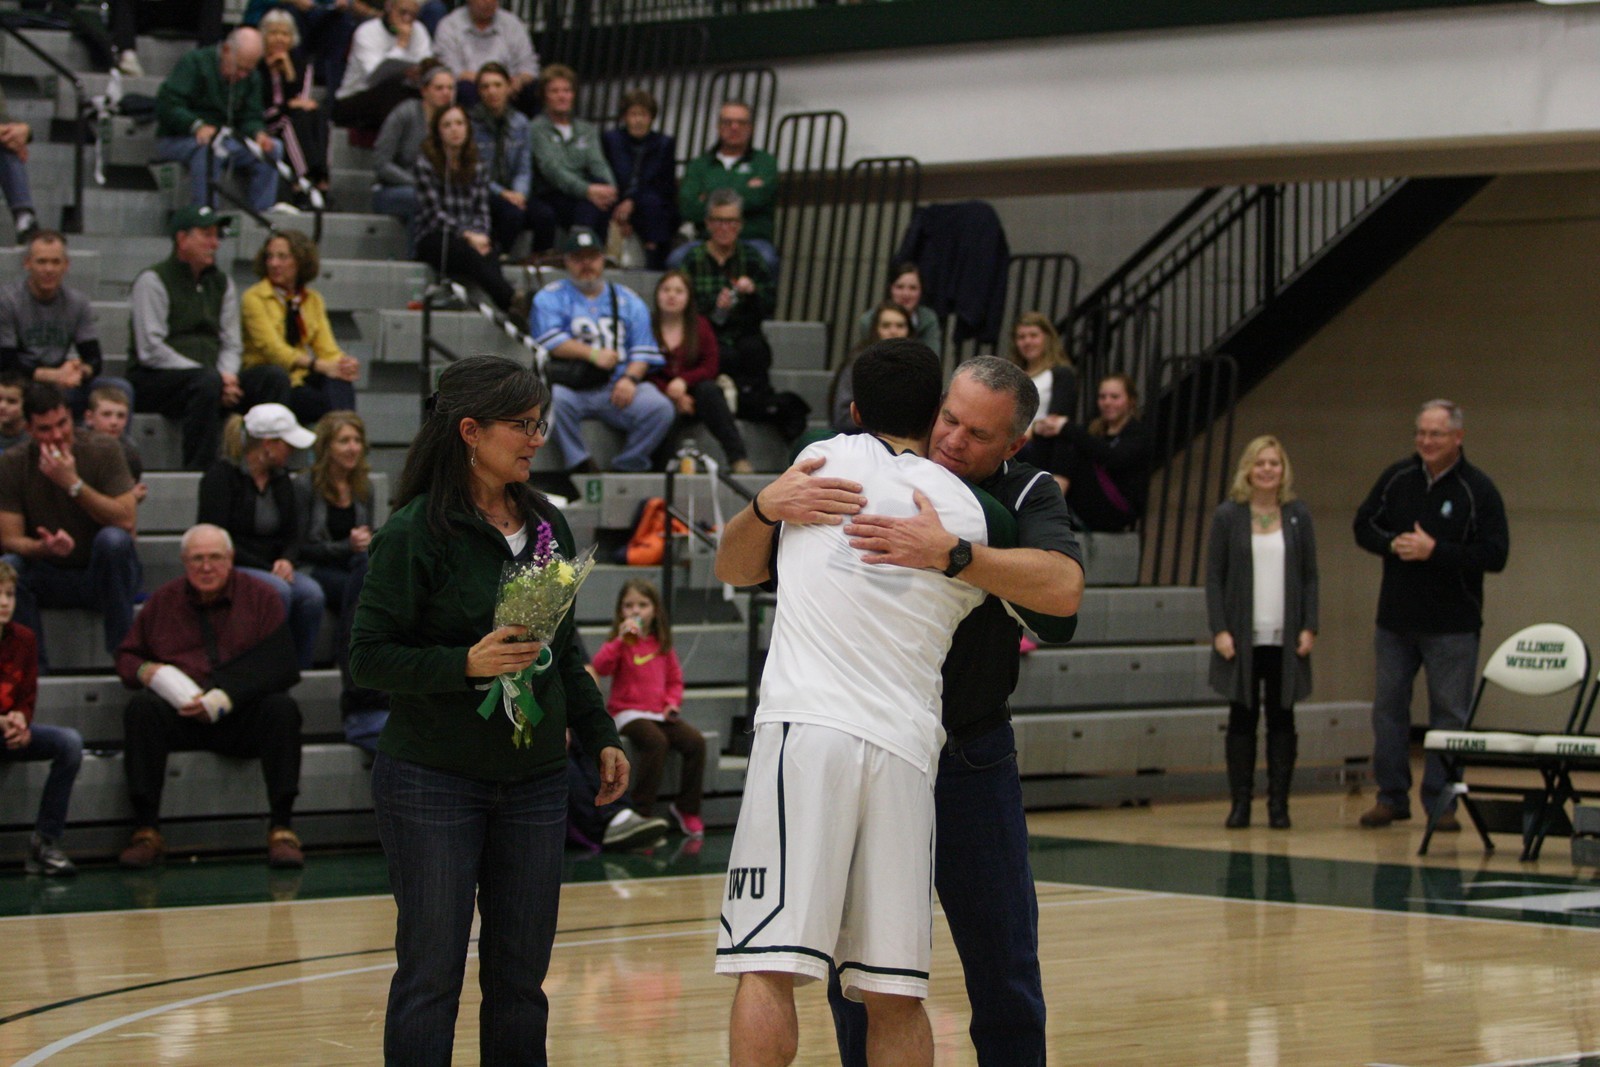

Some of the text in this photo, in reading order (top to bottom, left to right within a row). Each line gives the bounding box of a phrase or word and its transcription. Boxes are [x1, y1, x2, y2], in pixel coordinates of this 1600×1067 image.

[1516, 639, 1566, 653] ILLINOIS
[1505, 655, 1568, 670] WESLEYAN
[1445, 737, 1487, 752] TITANS
[1555, 741, 1597, 756] TITANS
[728, 867, 767, 901] IWU
